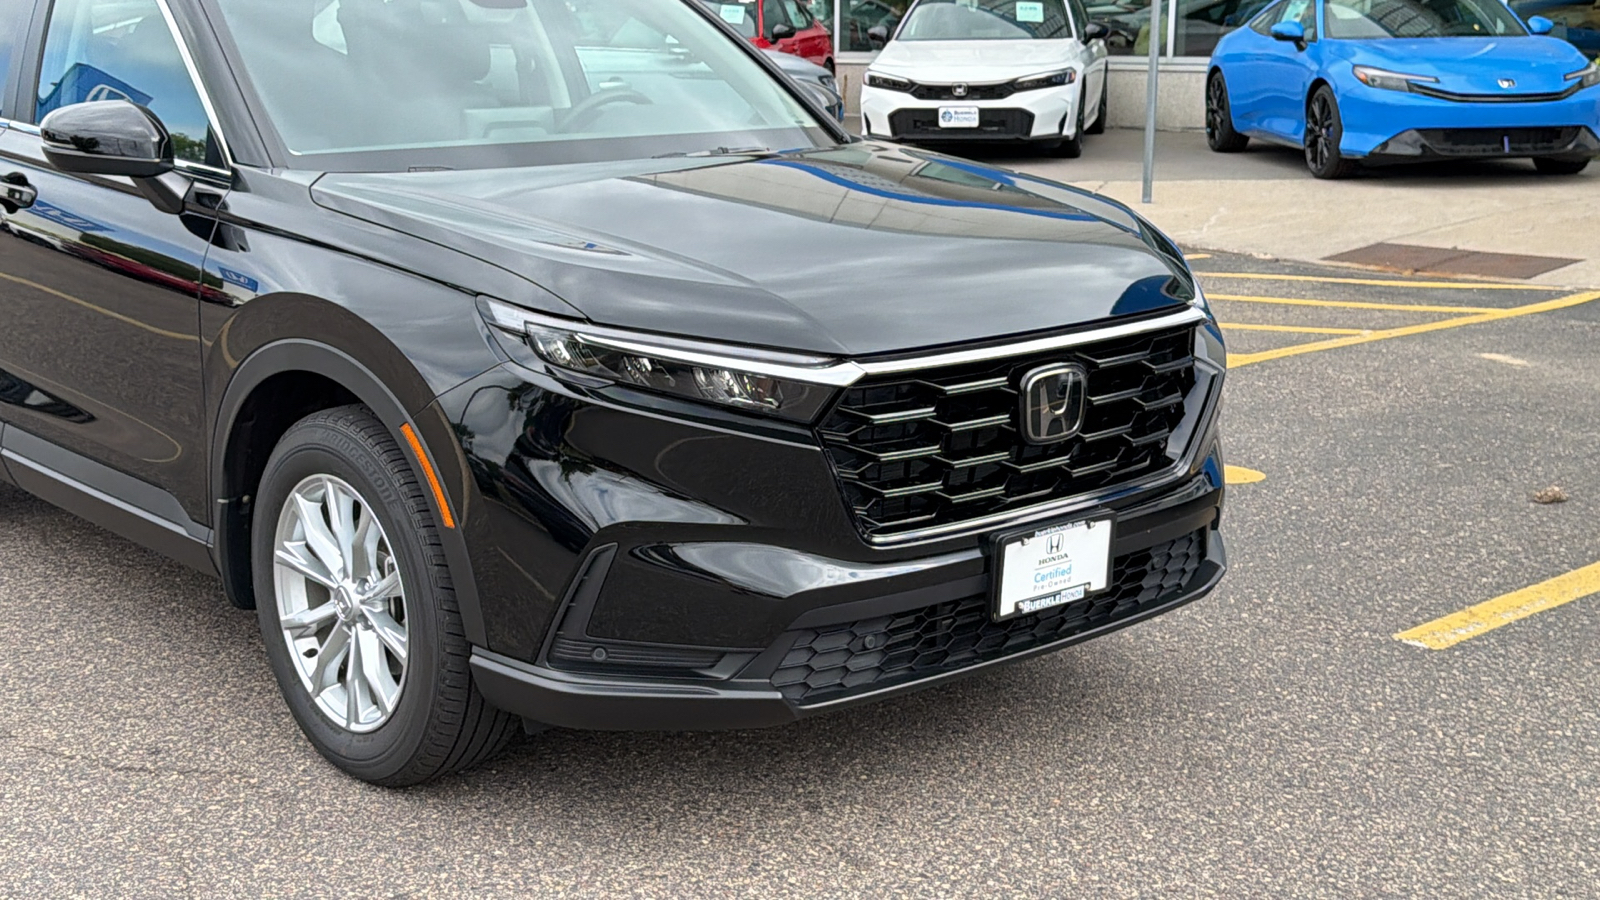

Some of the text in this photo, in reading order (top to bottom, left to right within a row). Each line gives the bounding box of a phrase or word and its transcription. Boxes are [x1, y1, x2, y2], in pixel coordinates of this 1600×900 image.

[1038, 552, 1069, 566] HONDA
[1034, 564, 1072, 583] Certified
[1033, 576, 1071, 592] Pre-Owned
